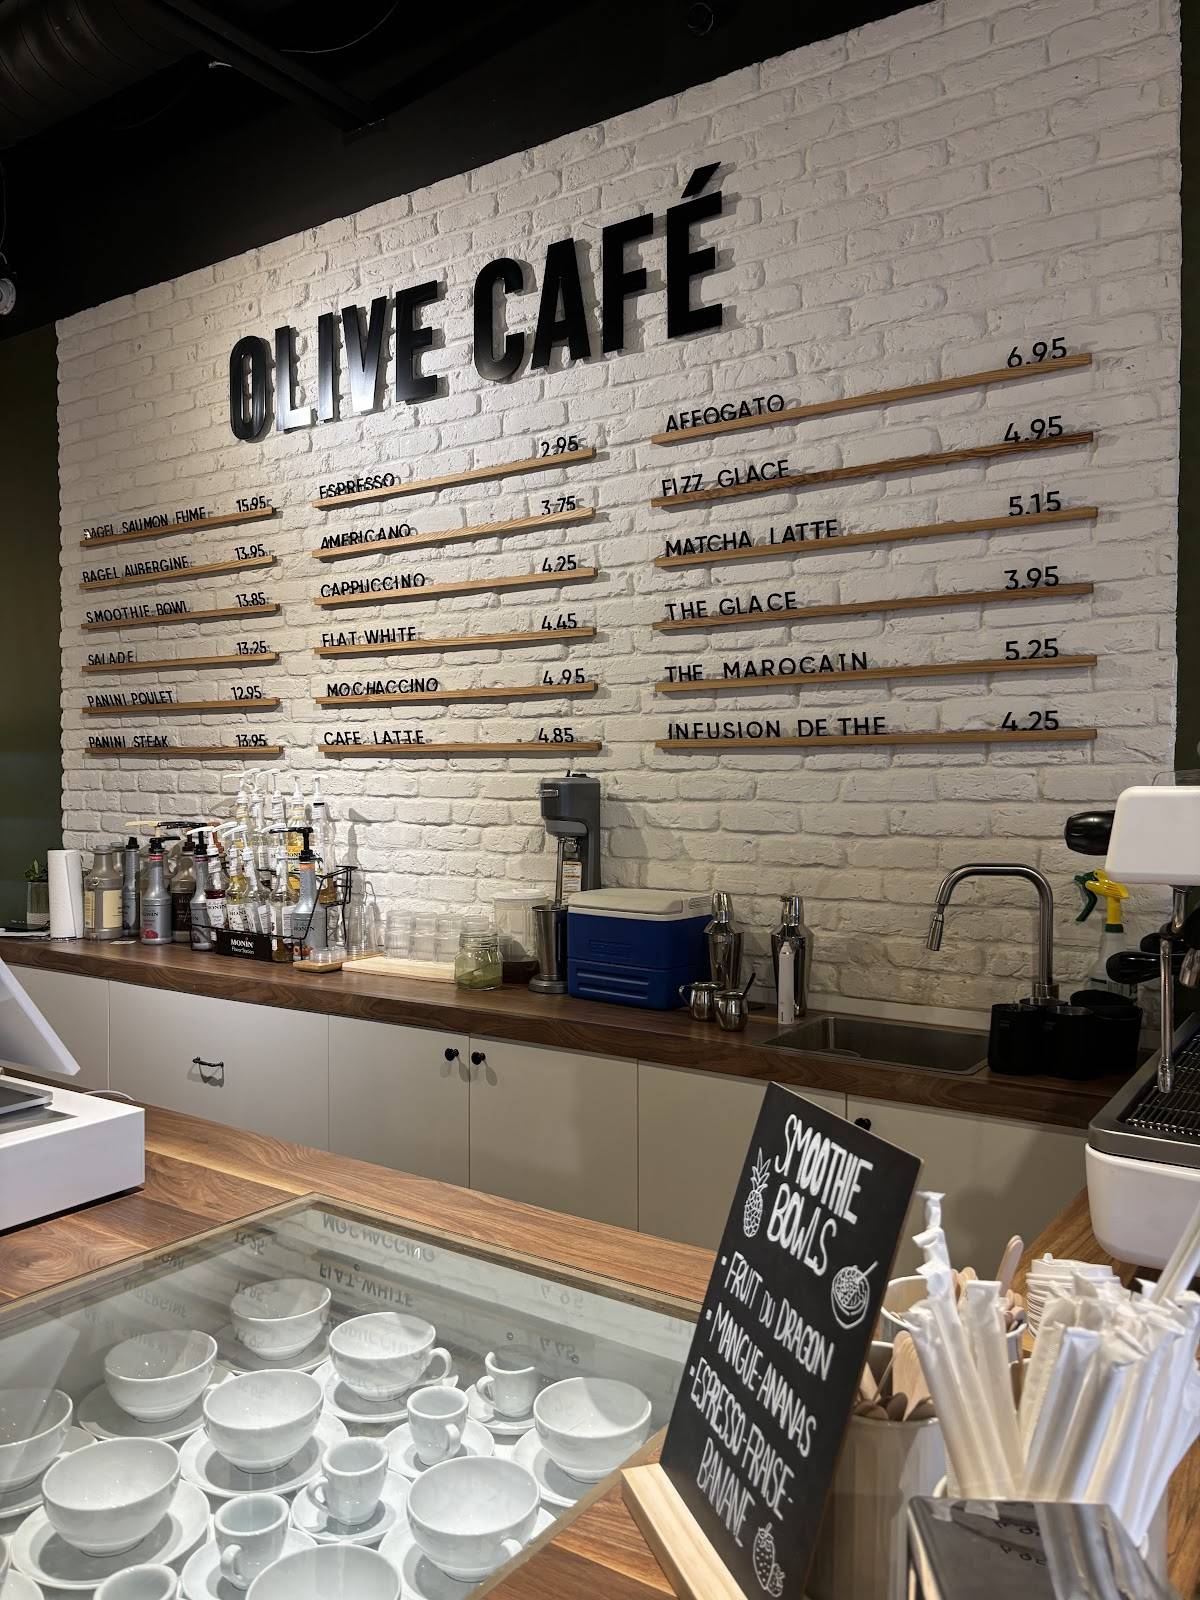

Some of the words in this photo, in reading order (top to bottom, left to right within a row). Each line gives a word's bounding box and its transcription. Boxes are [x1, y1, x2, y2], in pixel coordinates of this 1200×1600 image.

[229, 280, 438, 441] OLIVE
[473, 161, 723, 383] CAFÉ
[1007, 336, 1068, 369] 6.95
[664, 394, 785, 433] AFFOGATO
[1003, 415, 1064, 444] 4.95
[540, 435, 579, 458] 2.95
[318, 473, 396, 500] ESPRESSO
[661, 473, 705, 498] FIZZ
[717, 459, 790, 488] GLACE
[236, 495, 267, 513] 15.95
[541, 495, 577, 516] 3.75
[1008, 490, 1062, 518] 5.15
[122, 513, 169, 534] SAUMON
[175, 507, 206, 523] FUME
[320, 523, 411, 550] AMERICANO
[664, 531, 753, 558] MATCHA
[770, 519, 839, 545] LATTE
[234, 544, 266, 561] 13.95
[541, 554, 578, 573] 4.25
[320, 573, 426, 599] CAPPUCCINO
[1003, 565, 1060, 591] 3.95
[236, 592, 266, 608] 13.85
[664, 600, 708, 622] THE
[718, 591, 798, 618] GLACE
[86, 604, 150, 624] SMOOTHIE
[541, 612, 579, 631] 4.45
[321, 630, 358, 648] FLAT
[364, 627, 417, 645] WHITE
[1004, 637, 1060, 662] 5.25
[87, 651, 134, 666] SALADE
[664, 664, 704, 683] THE
[722, 651, 868, 680] MAROCAIN
[326, 677, 439, 698] MOCHACCINO
[542, 667, 586, 687] 4.95
[86, 694, 127, 708] PANINI
[131, 690, 174, 706] POULET
[231, 685, 262, 700] 12.95
[667, 719, 782, 741] INFUSION
[797, 718, 828, 738] DE
[837, 716, 887, 737] THE
[1001, 710, 1060, 732] 4.25
[88, 735, 126, 748] PANINI
[133, 735, 169, 748] STEAK
[236, 734, 267, 748] 13.95
[323, 731, 362, 746] CAFE
[373, 730, 426, 746] LATTE
[538, 727, 575, 744] 4.85
[774, 1113, 874, 1226] SMOOTHIE
[766, 1182, 838, 1277] BOWLS
[724, 1250, 764, 1297] FRUIT
[773, 1298, 835, 1382] DRAGON
[709, 1307, 817, 1459] MANGUE-ANANAS
[696, 1436, 756, 1548] BANANE
